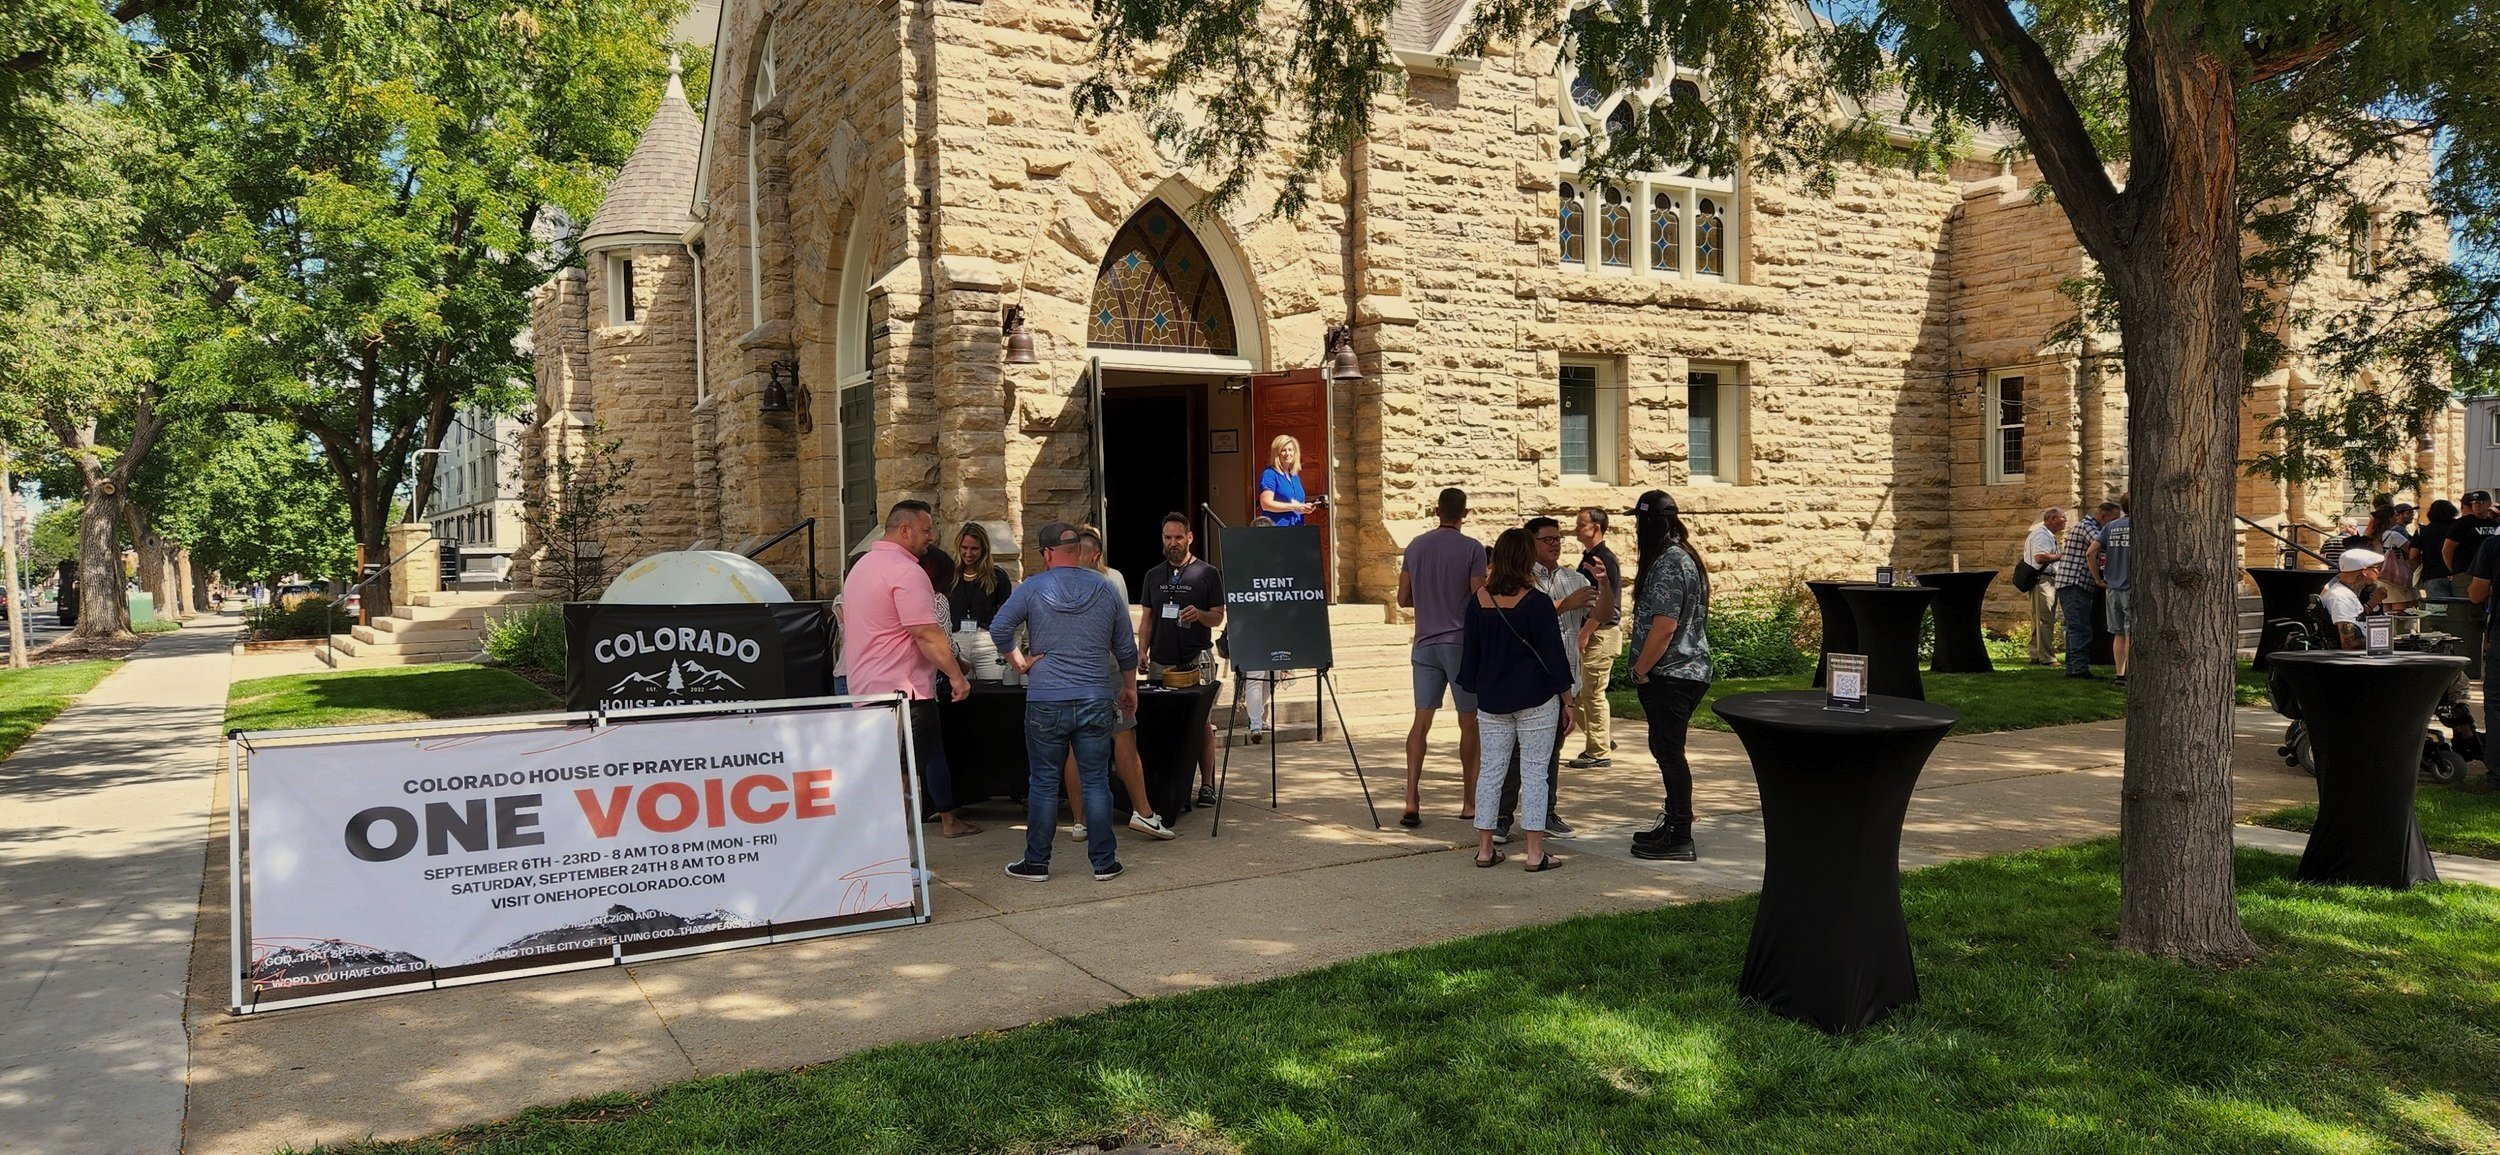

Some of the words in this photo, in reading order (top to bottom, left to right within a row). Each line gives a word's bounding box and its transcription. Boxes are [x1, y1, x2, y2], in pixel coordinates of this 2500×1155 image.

[1227, 589, 1325, 603] REGISTRATION
[1252, 577, 1294, 589] EVENT
[594, 627, 761, 664] COLORADO
[599, 699, 656, 711] HOUSE
[403, 771, 526, 794] COLORADO
[529, 765, 600, 784] HOUSE
[603, 762, 629, 777] OF
[632, 757, 708, 775] PRAYER
[710, 751, 785, 769] LAUNCH
[344, 793, 545, 862] ONE
[573, 769, 837, 839] VOICE
[423, 860, 518, 881] SEPTEMBER
[521, 856, 552, 871] 6TH
[562, 851, 601, 866] 23RD
[612, 849, 621, 860] 8
[623, 847, 647, 859] AM
[649, 844, 669, 856] TO
[671, 843, 680, 854] 8
[682, 841, 704, 853] PM
[706, 836, 743, 852] (MON
[753, 833, 778, 846] FRI)
[451, 875, 537, 895] SATURDAY,
[538, 865, 628, 885] SEPTEMBER
[631, 861, 667, 875] 24TH
[670, 859, 679, 870] 8
[681, 857, 704, 869] AM
[705, 855, 725, 867] TO
[727, 854, 736, 865] 8
[738, 851, 760, 863] PM
[490, 894, 531, 909] VISIT
[533, 872, 726, 905] ONEHOPECOLORADO.COM
[635, 910, 657, 920] AND
[313, 971, 338, 983] YOU
[340, 967, 371, 980] HAVE
[372, 963, 407, 975] COME
[407, 961, 424, 972] TO
[519, 946, 534, 956] TO
[535, 944, 556, 954] THE
[557, 939, 581, 951] CITY
[582, 938, 596, 948] OF
[597, 935, 618, 945] THE
[619, 931, 651, 943] LIVING
